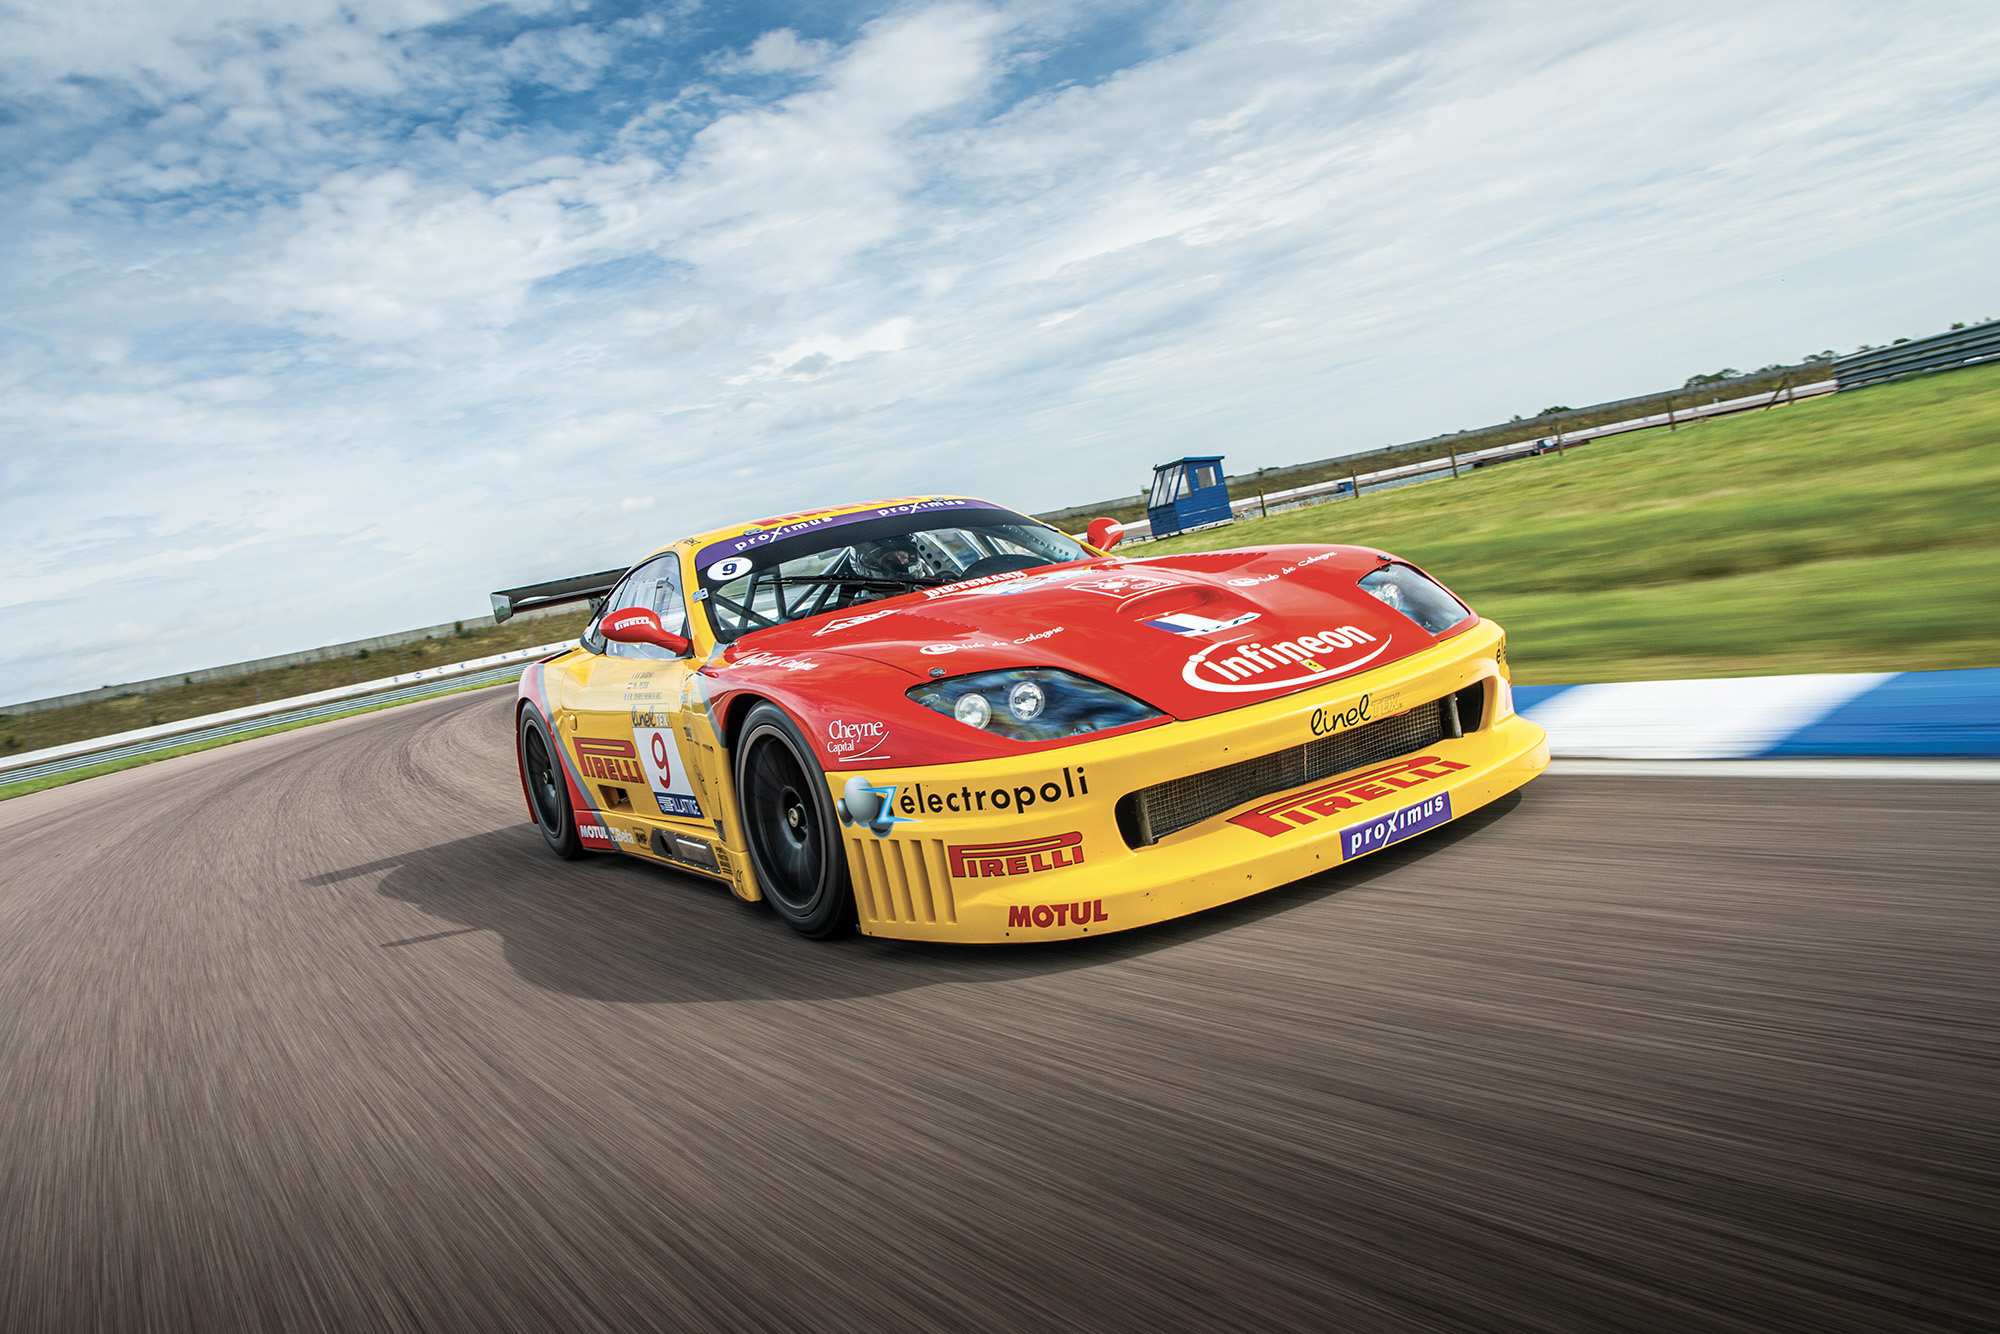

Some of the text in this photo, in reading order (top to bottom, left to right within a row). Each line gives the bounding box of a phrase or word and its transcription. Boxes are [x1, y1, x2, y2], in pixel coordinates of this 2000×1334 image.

[877, 499, 966, 517] proximus
[735, 517, 833, 551] proximus
[722, 563, 737, 576] 9
[614, 616, 649, 631] PIRELLI
[1013, 626, 1065, 645] Cologne
[1204, 625, 1377, 682] Infineon
[828, 720, 884, 743] Cheyne
[572, 737, 645, 784] PIRELLI
[651, 732, 671, 789] 9
[827, 739, 855, 755] Capital
[900, 767, 1089, 814] électropoli
[1226, 756, 1471, 838] PIRELLI
[580, 825, 608, 839] MOTUL
[615, 827, 634, 844] Beta
[1351, 796, 1444, 855] proximus
[947, 831, 1085, 878] PIRELLI
[1008, 899, 1108, 928] MOTUL
